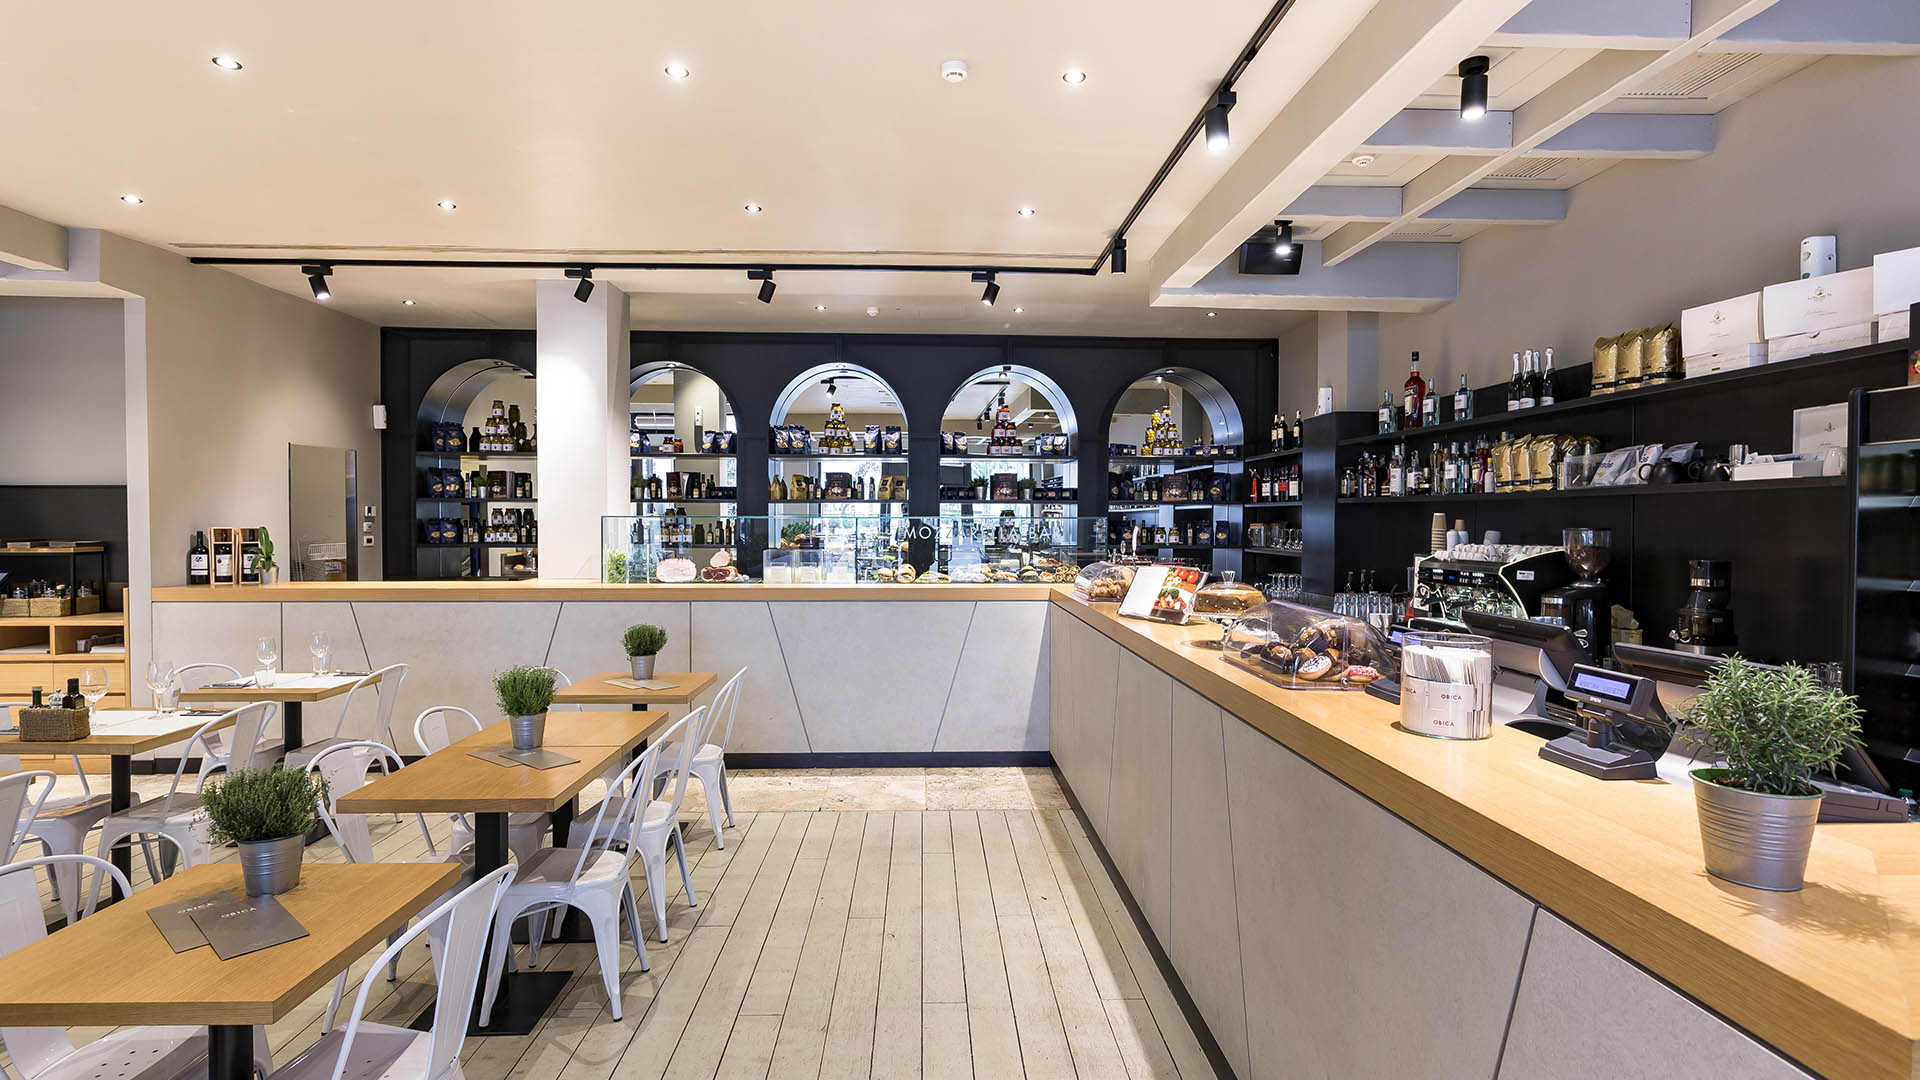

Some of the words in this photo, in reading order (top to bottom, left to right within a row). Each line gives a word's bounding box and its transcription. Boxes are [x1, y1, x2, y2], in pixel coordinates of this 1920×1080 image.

[903, 526, 1018, 540] MOZZARELLA
[1029, 526, 1065, 540] BAR
[1440, 693, 1463, 701] OBICA
[1432, 719, 1455, 727] OBICA
[220, 907, 257, 919] OBICA
